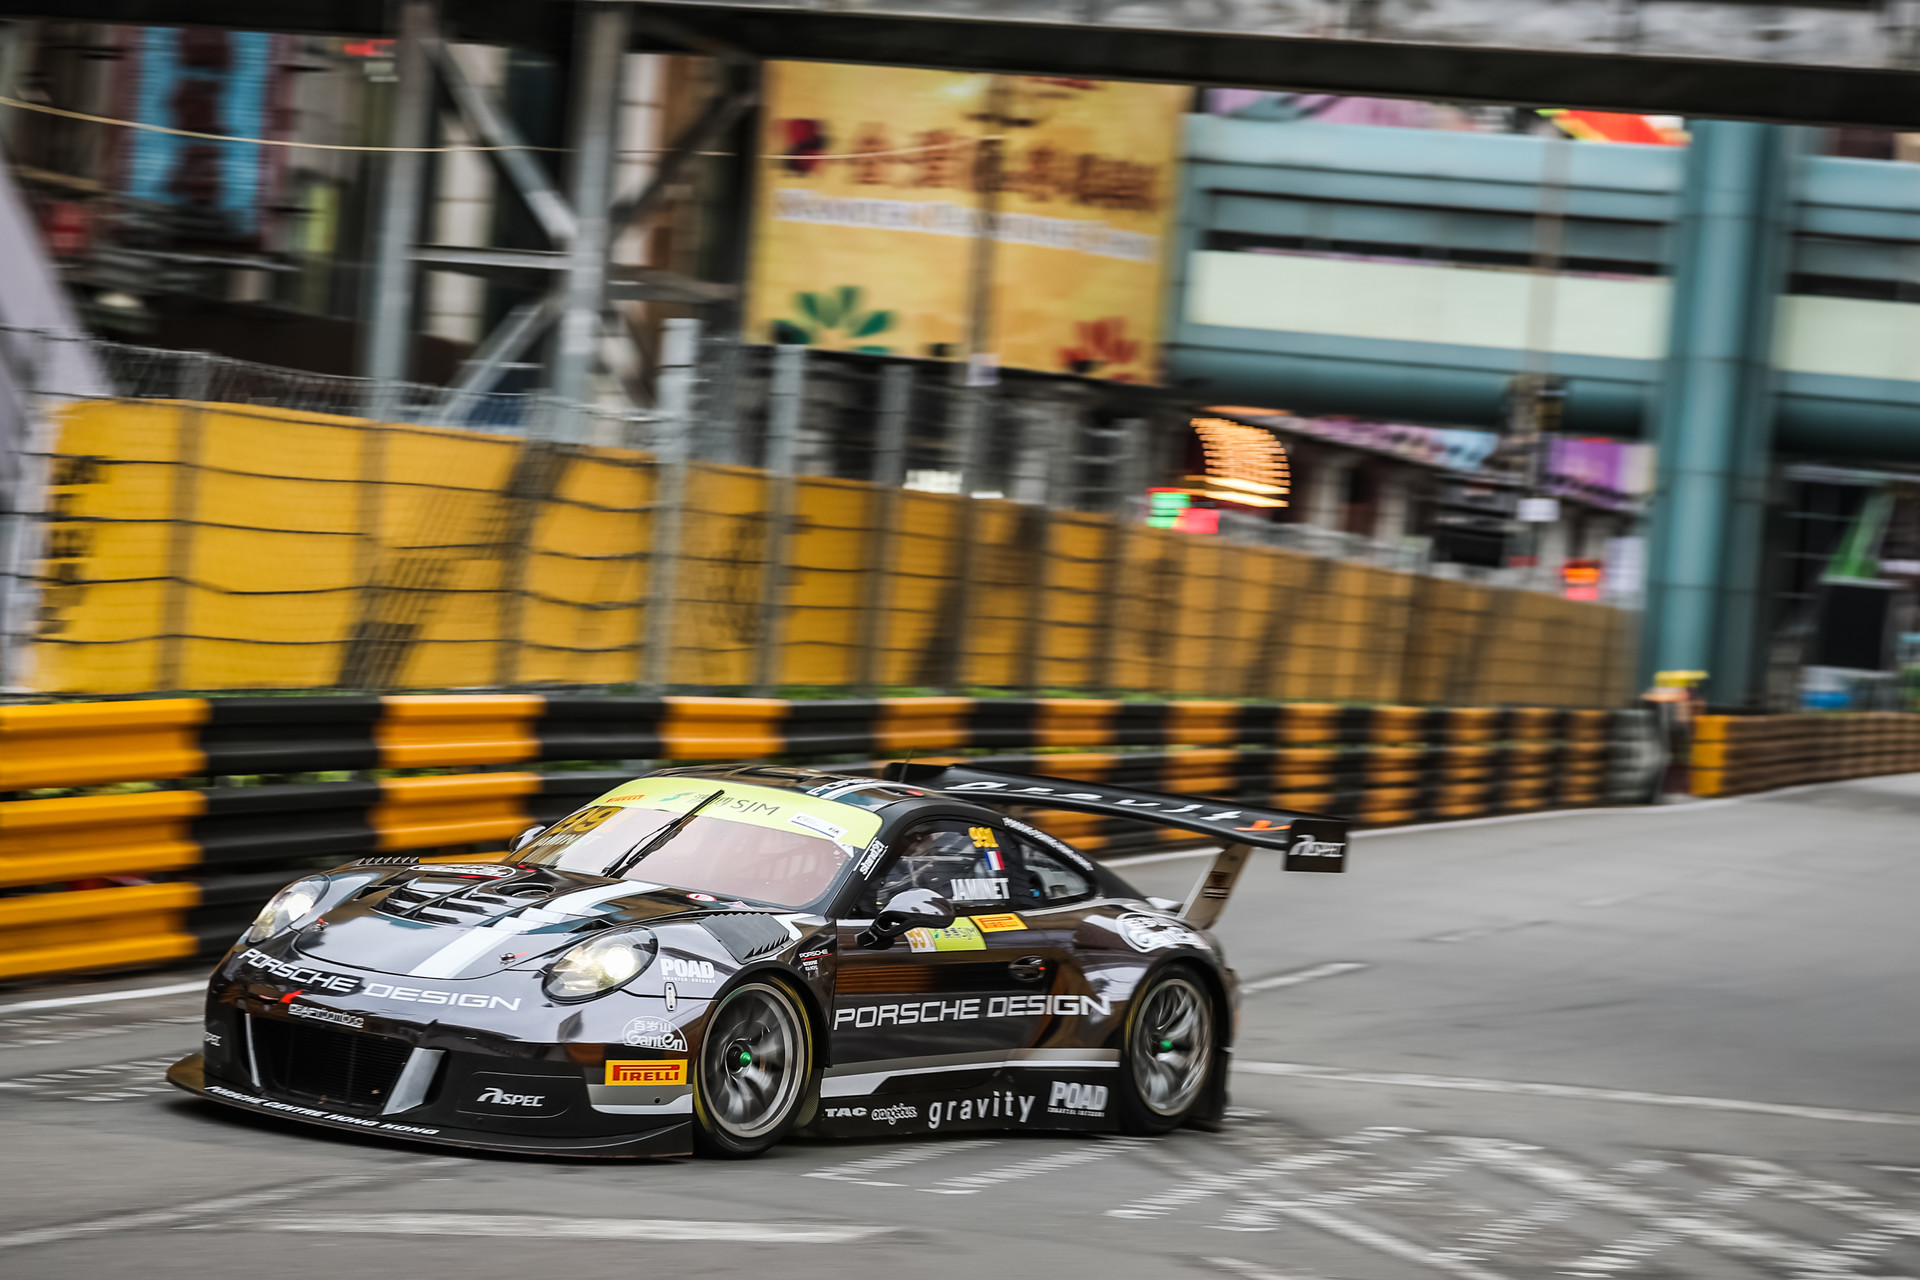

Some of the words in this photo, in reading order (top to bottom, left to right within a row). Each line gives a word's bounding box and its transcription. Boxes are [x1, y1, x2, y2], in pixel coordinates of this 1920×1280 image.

[731, 799, 781, 816] SJM
[798, 948, 829, 959] PORSCHE
[659, 958, 715, 979] POAD
[238, 948, 360, 993] PORSCHE
[362, 981, 522, 1012] DESIGN
[833, 998, 981, 1031] PORSCHE
[986, 995, 1112, 1018] DESIGN
[633, 1020, 672, 1033] 百岁山
[625, 1030, 685, 1051] Ganten
[612, 1064, 680, 1081] PIRELLI
[1048, 1081, 1109, 1110] POAD
[204, 1085, 263, 1106] PORSCHE
[262, 1099, 327, 1118] CENTRE
[325, 1113, 381, 1128] HONG
[378, 1122, 440, 1136] KONG
[825, 1106, 867, 1118] TAC
[928, 1090, 1036, 1129] gravity
